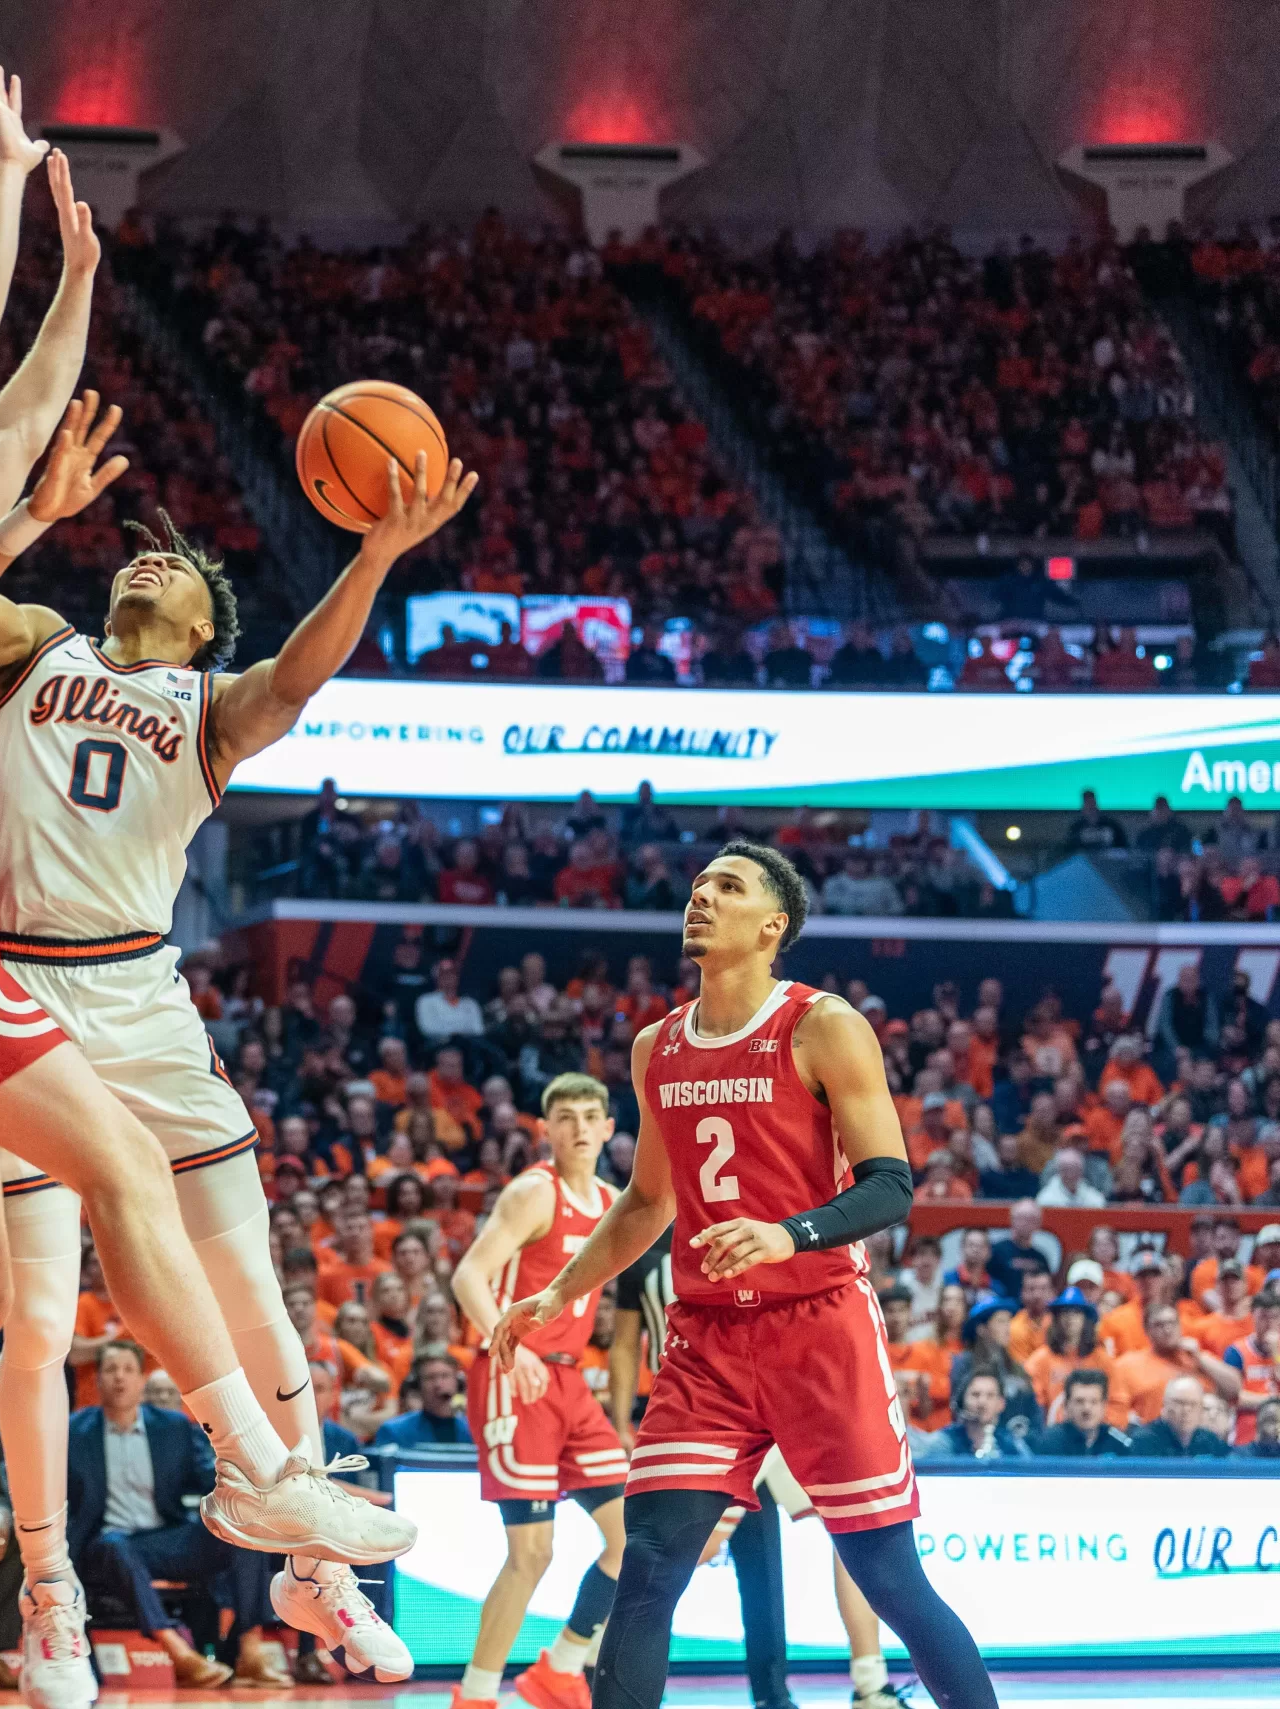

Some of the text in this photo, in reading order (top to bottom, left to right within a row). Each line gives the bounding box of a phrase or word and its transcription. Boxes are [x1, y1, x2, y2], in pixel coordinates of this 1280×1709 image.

[30, 674, 185, 764] Illinois
[502, 722, 566, 753] OUR
[580, 723, 780, 759] COMMUNITY
[67, 738, 129, 813] 0
[658, 1077, 774, 1109] WISCONSIN
[695, 1116, 740, 1203] 2
[1153, 1526, 1233, 1573] OUR
